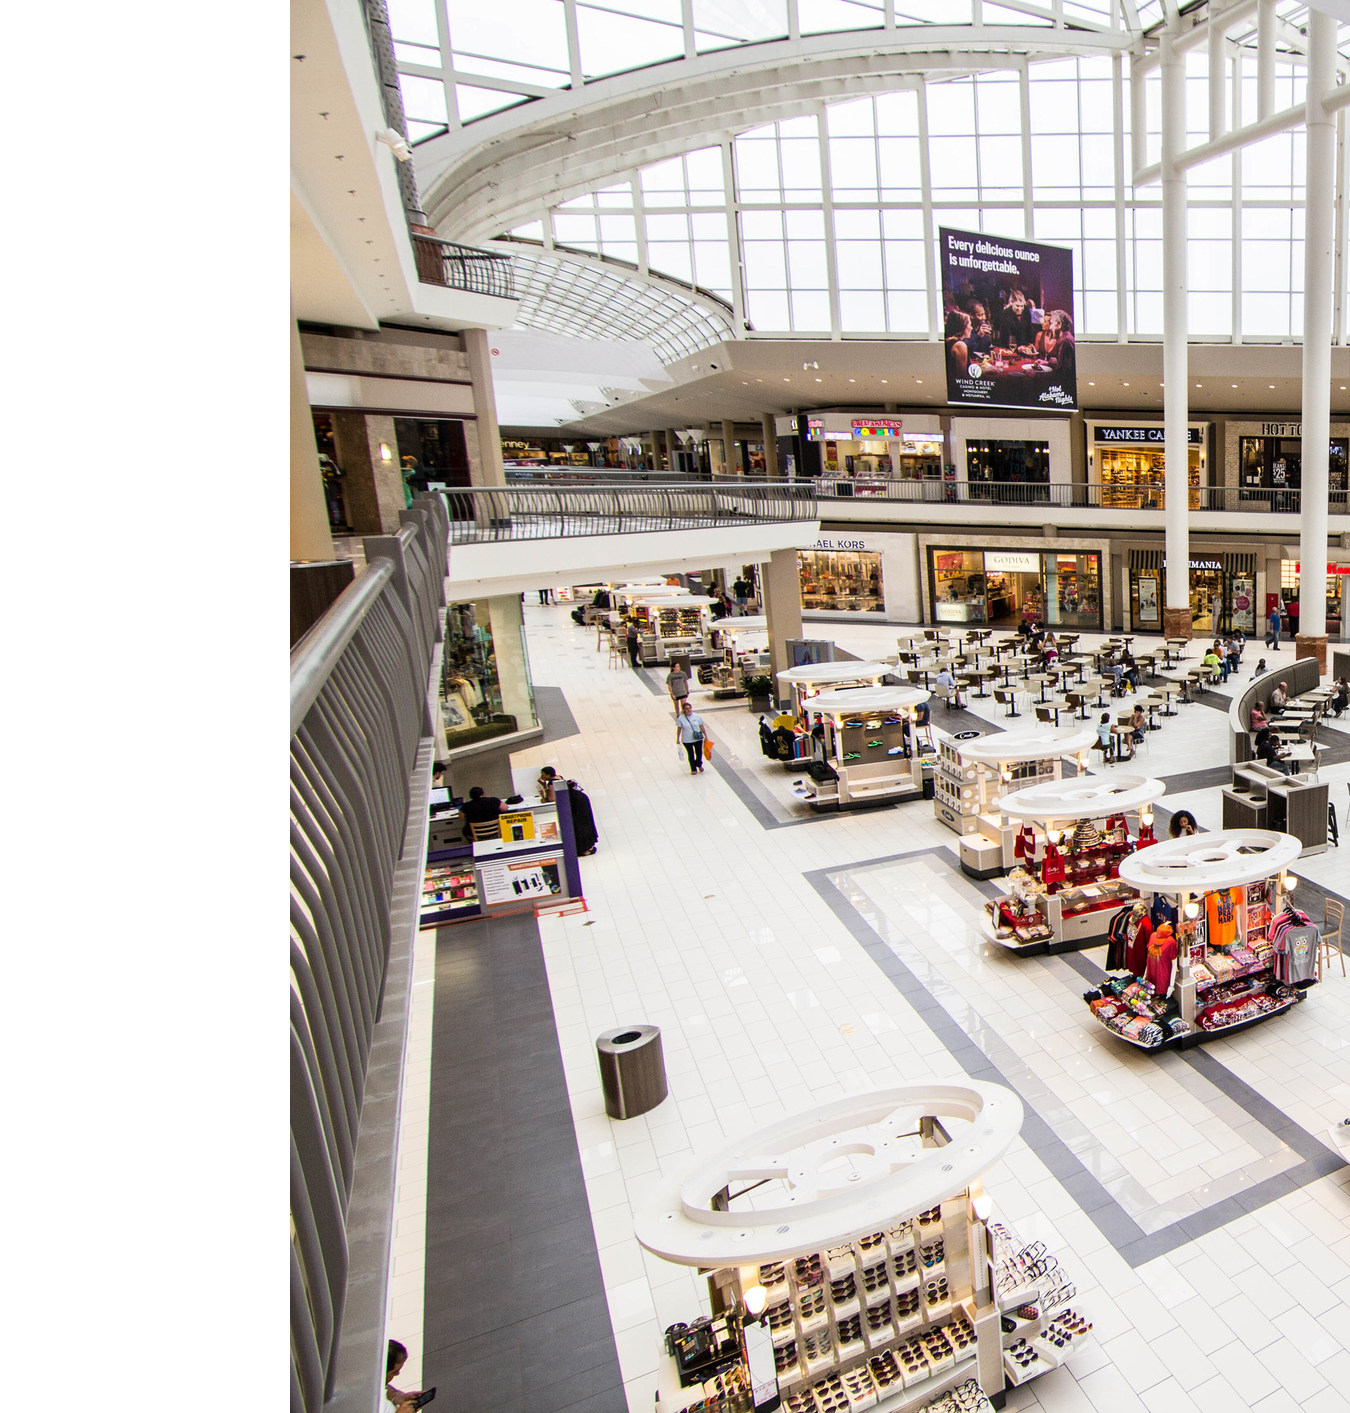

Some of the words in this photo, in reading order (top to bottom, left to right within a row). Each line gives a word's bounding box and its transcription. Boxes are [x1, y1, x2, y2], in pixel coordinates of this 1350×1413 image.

[948, 235, 974, 254] Every
[976, 240, 1014, 258] delicious
[1015, 249, 1040, 262] ounce
[950, 253, 958, 265] is
[959, 254, 1020, 274] unforgettable.
[854, 427, 900, 436] COOKIES
[1102, 429, 1146, 440] YANKEE
[1262, 424, 1287, 435] HOT
[1273, 468, 1286, 479] $25
[838, 540, 865, 549] KORS
[993, 556, 1030, 564] GODIVA
